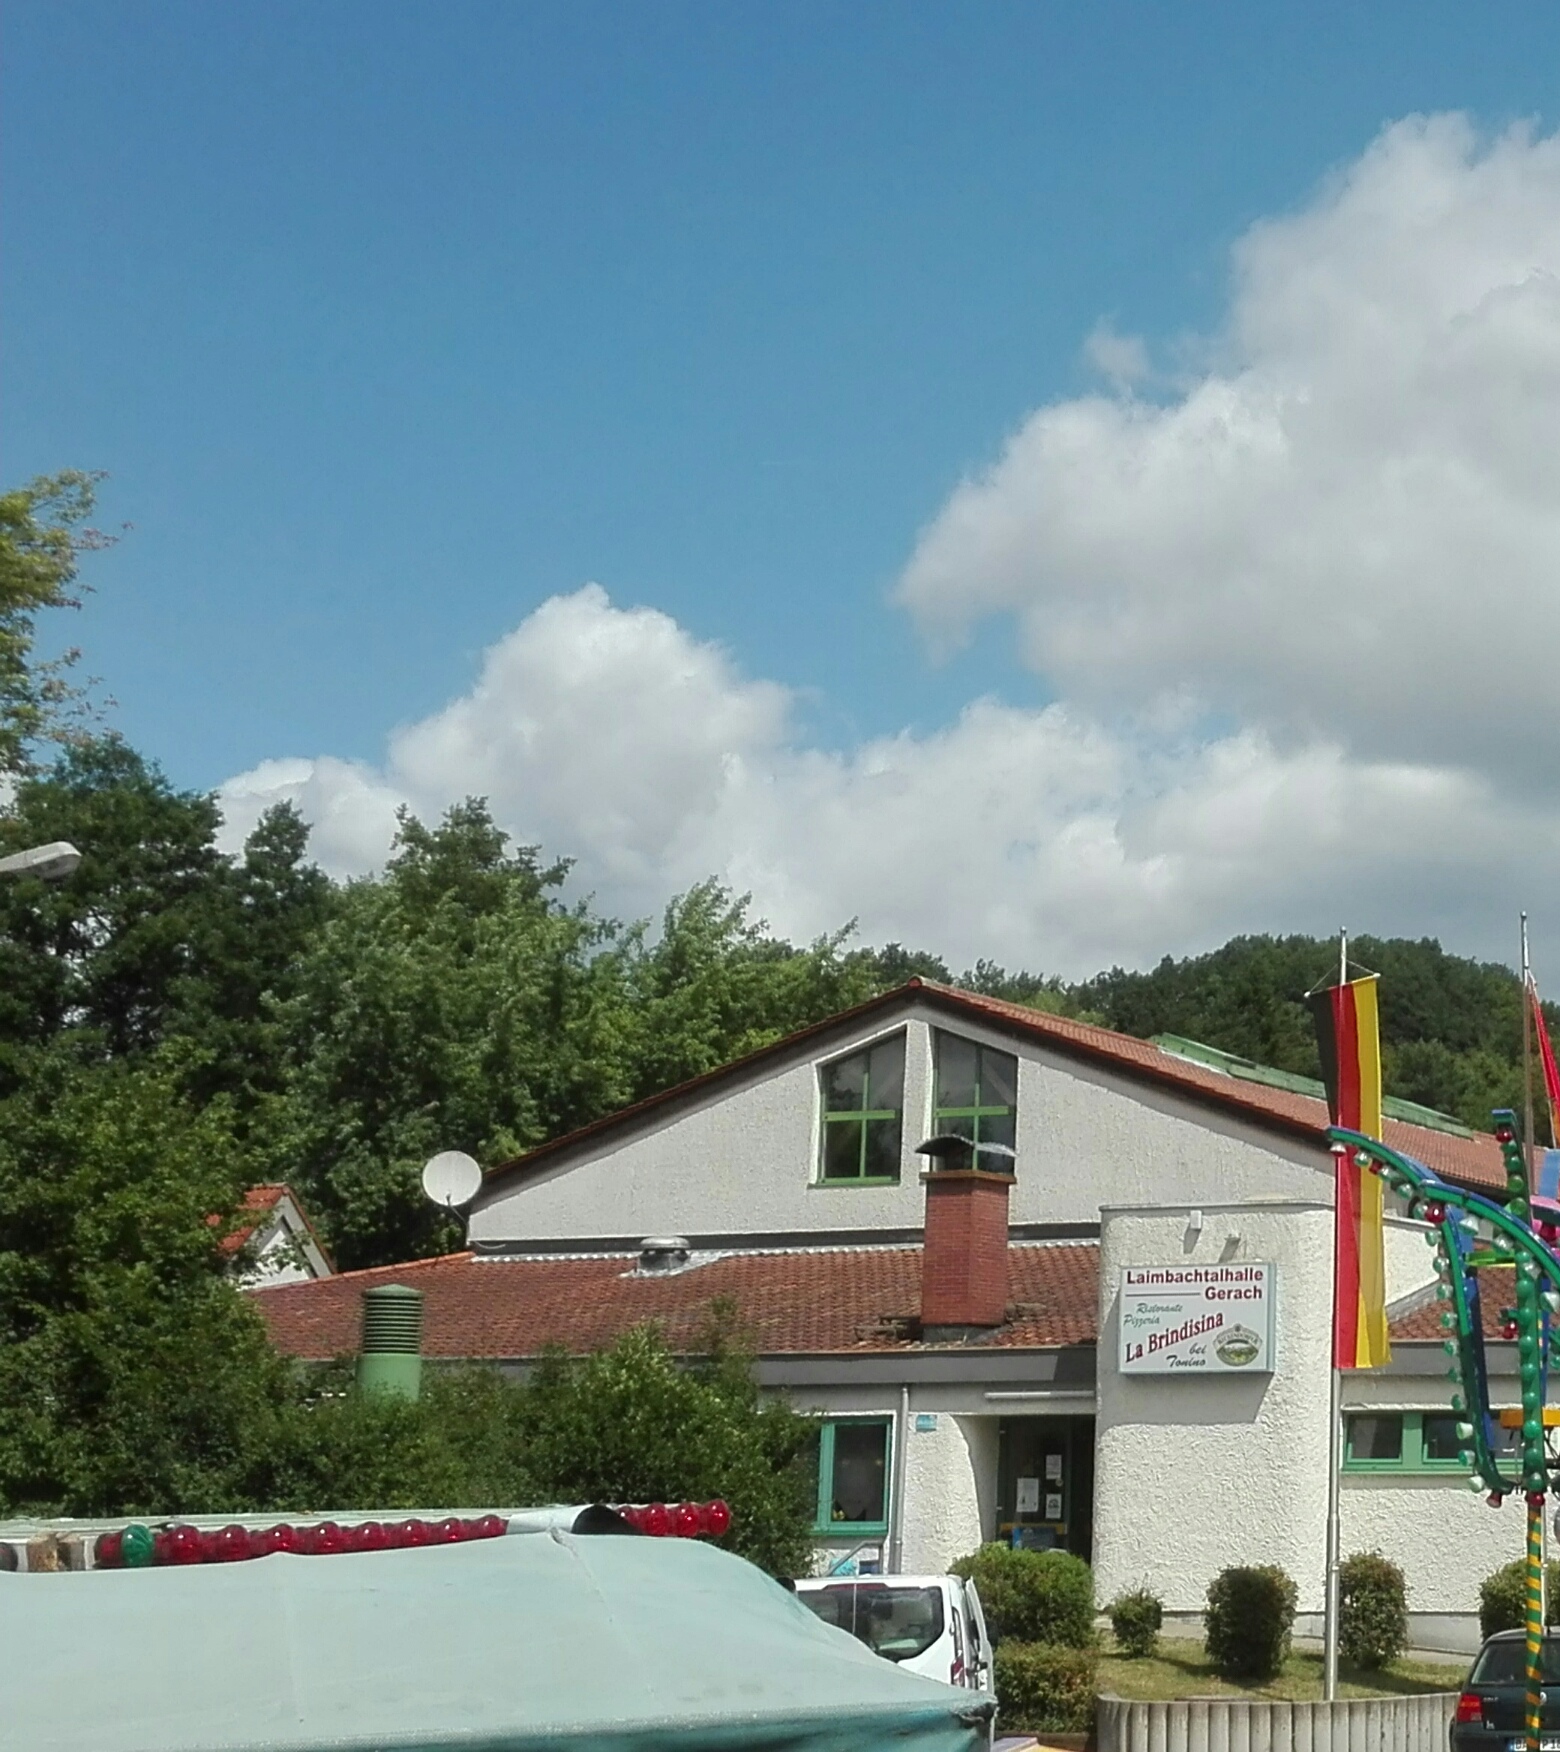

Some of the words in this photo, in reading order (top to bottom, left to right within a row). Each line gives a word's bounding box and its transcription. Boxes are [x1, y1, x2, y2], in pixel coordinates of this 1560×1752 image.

[1126, 1267, 1264, 1285] Laimbachtalhalle
[1204, 1285, 1263, 1300] Gerach
[1135, 1302, 1183, 1313] Ristorante
[1123, 1314, 1161, 1328] Pizzeria
[1125, 1342, 1144, 1364] La
[1147, 1311, 1225, 1355] Brindisina
[1189, 1342, 1208, 1355] bei
[1166, 1354, 1207, 1368] Tonino
